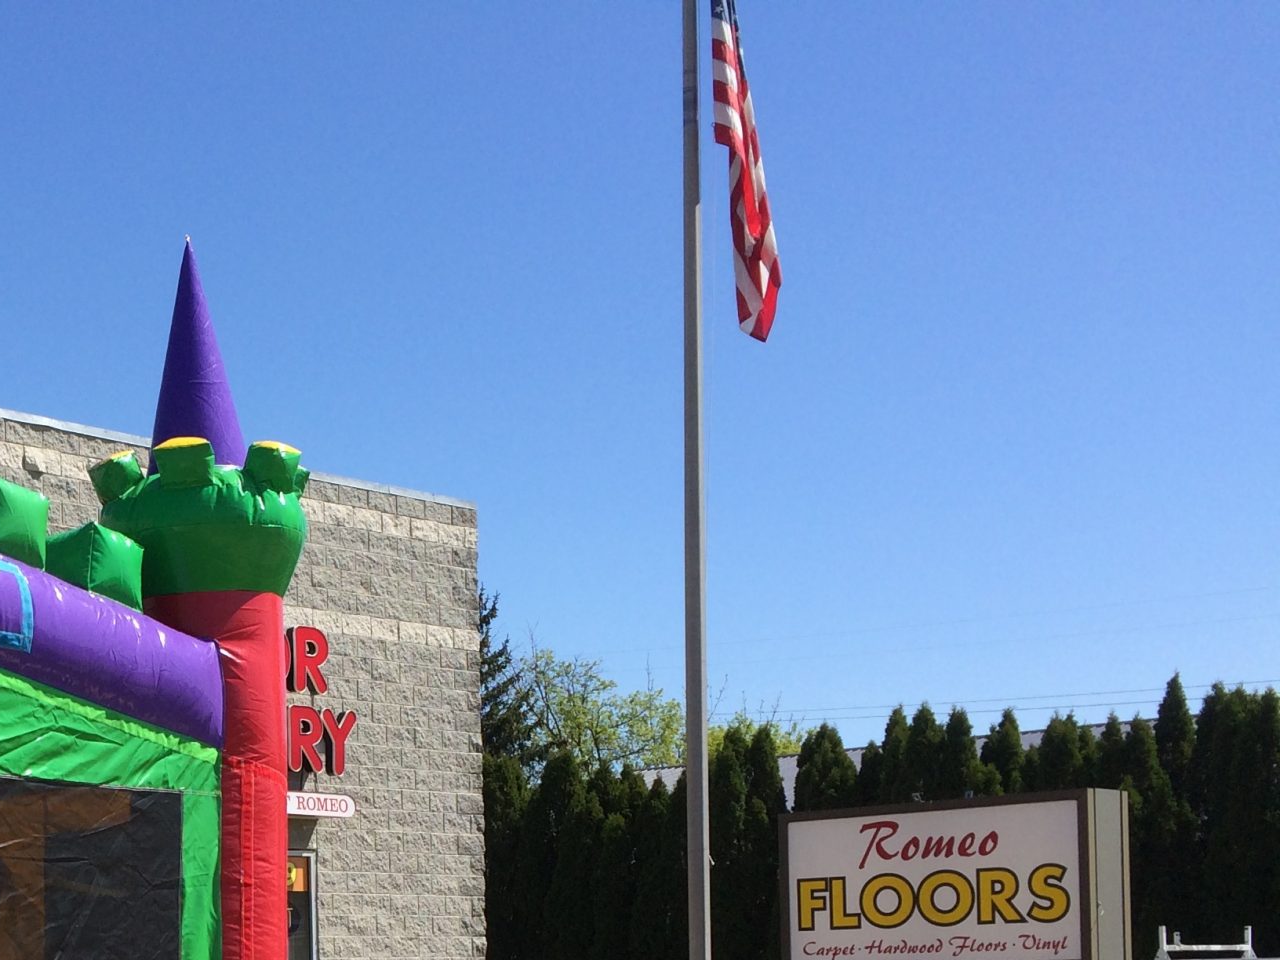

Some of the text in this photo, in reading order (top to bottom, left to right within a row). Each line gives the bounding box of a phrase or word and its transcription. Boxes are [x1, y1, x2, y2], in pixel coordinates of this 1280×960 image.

[296, 795, 349, 813] ROMEO
[859, 821, 999, 869] Romeo
[797, 863, 1071, 931] FLOORS
[803, 934, 1068, 960] Carpet Hardwood Floors Vinyl
